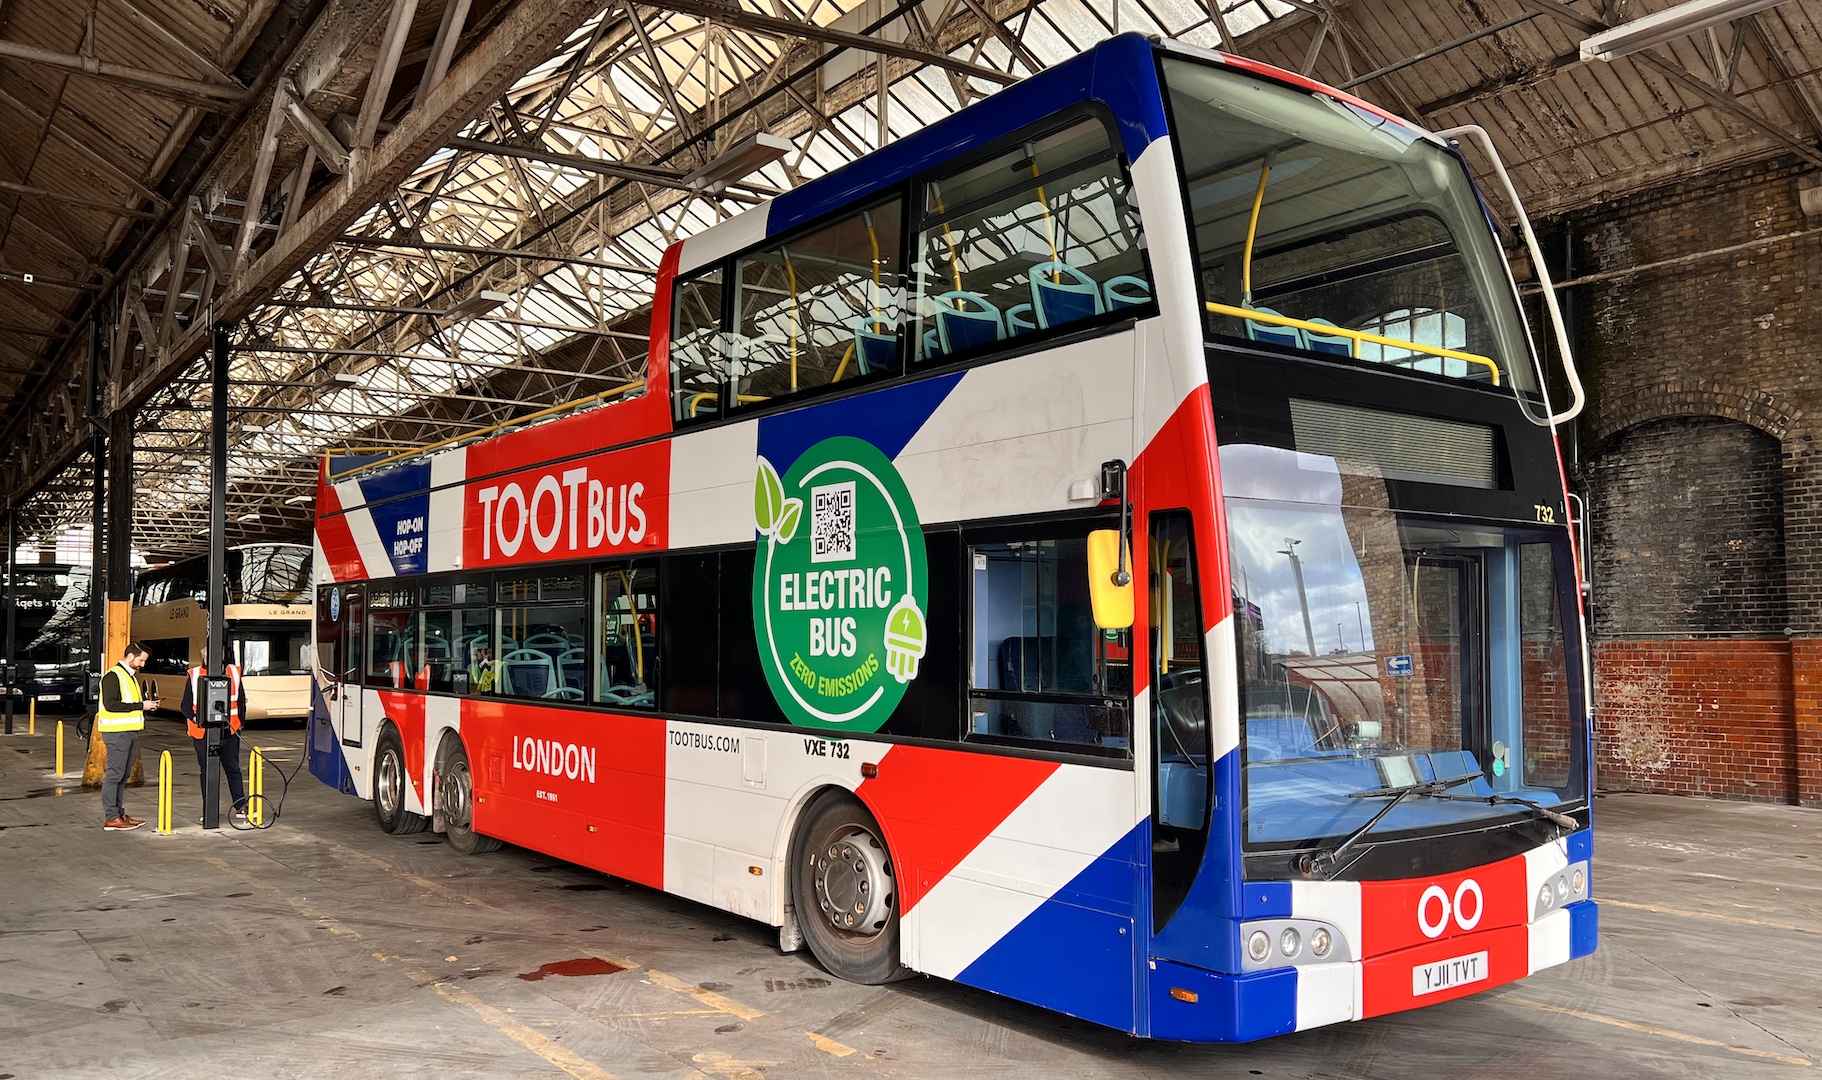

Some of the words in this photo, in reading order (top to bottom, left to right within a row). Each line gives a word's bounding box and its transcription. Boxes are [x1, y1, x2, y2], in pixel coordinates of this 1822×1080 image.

[397, 516, 424, 535] HOP-ON
[478, 467, 647, 559] TOOTBUS
[1534, 504, 1554, 523] 732
[393, 537, 423, 556] HOP-OFF
[780, 566, 892, 611] ELECTRIC
[810, 616, 857, 657] BUS
[789, 652, 816, 690] ZERO
[817, 652, 879, 698] EMISSIONS
[669, 730, 740, 754] TOOTBUS.COM
[803, 738, 826, 757] VXE
[830, 741, 850, 760] 732
[513, 735, 596, 784] LONDON
[1453, 957, 1478, 983] TVT
